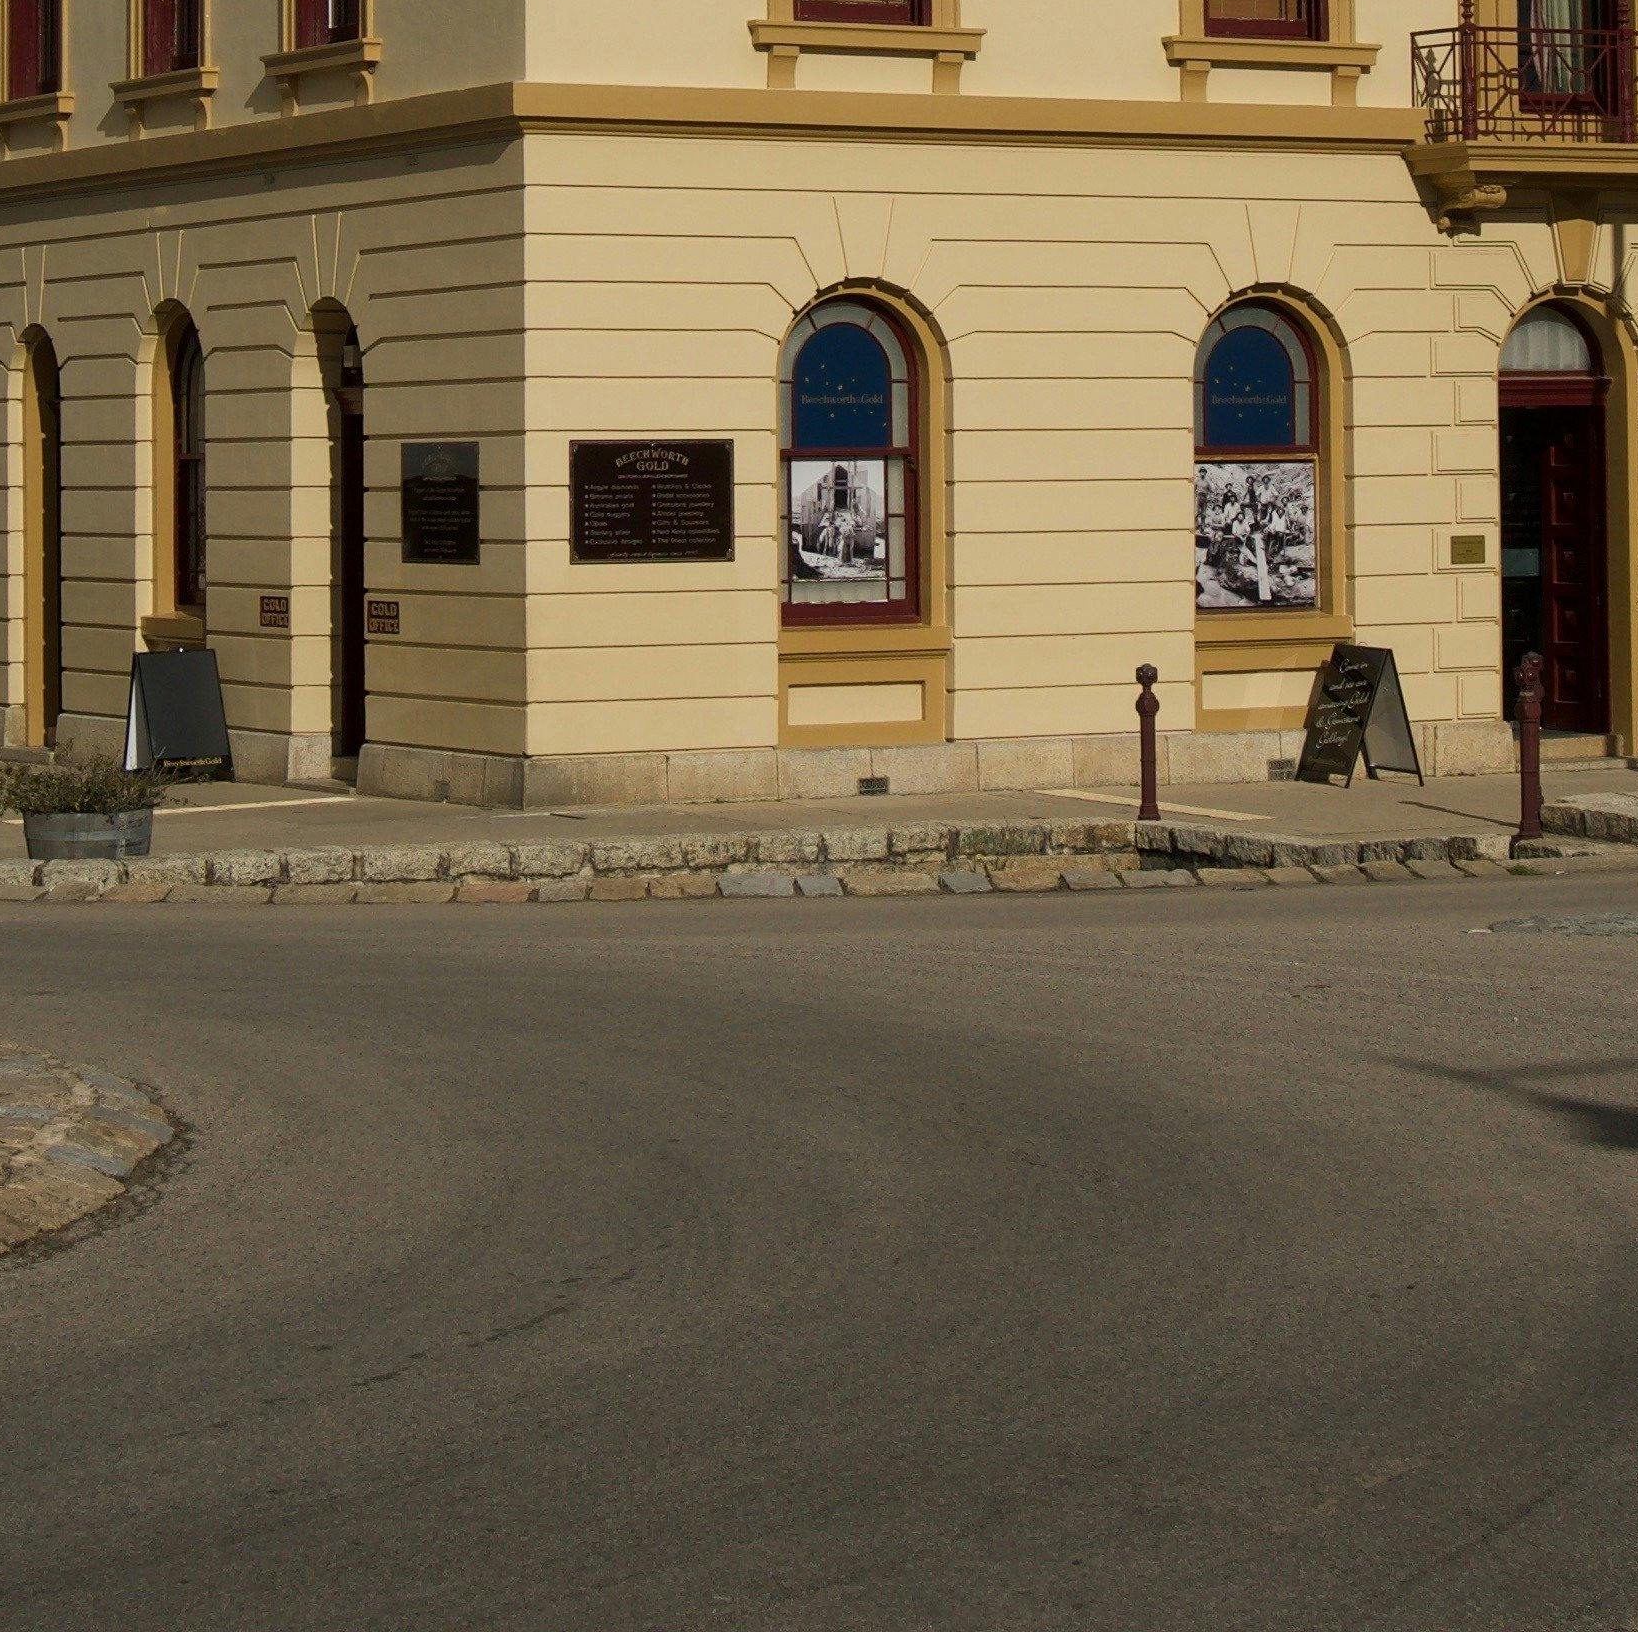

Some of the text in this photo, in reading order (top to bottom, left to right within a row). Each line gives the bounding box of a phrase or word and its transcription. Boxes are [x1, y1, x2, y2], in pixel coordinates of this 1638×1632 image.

[615, 448, 690, 467] BEECHWORTH
[637, 460, 669, 471] GOLD
[263, 598, 287, 612] GOLD
[371, 603, 398, 617] GOLD
[262, 613, 289, 626] OFFICE
[368, 619, 399, 633] OFFICE
